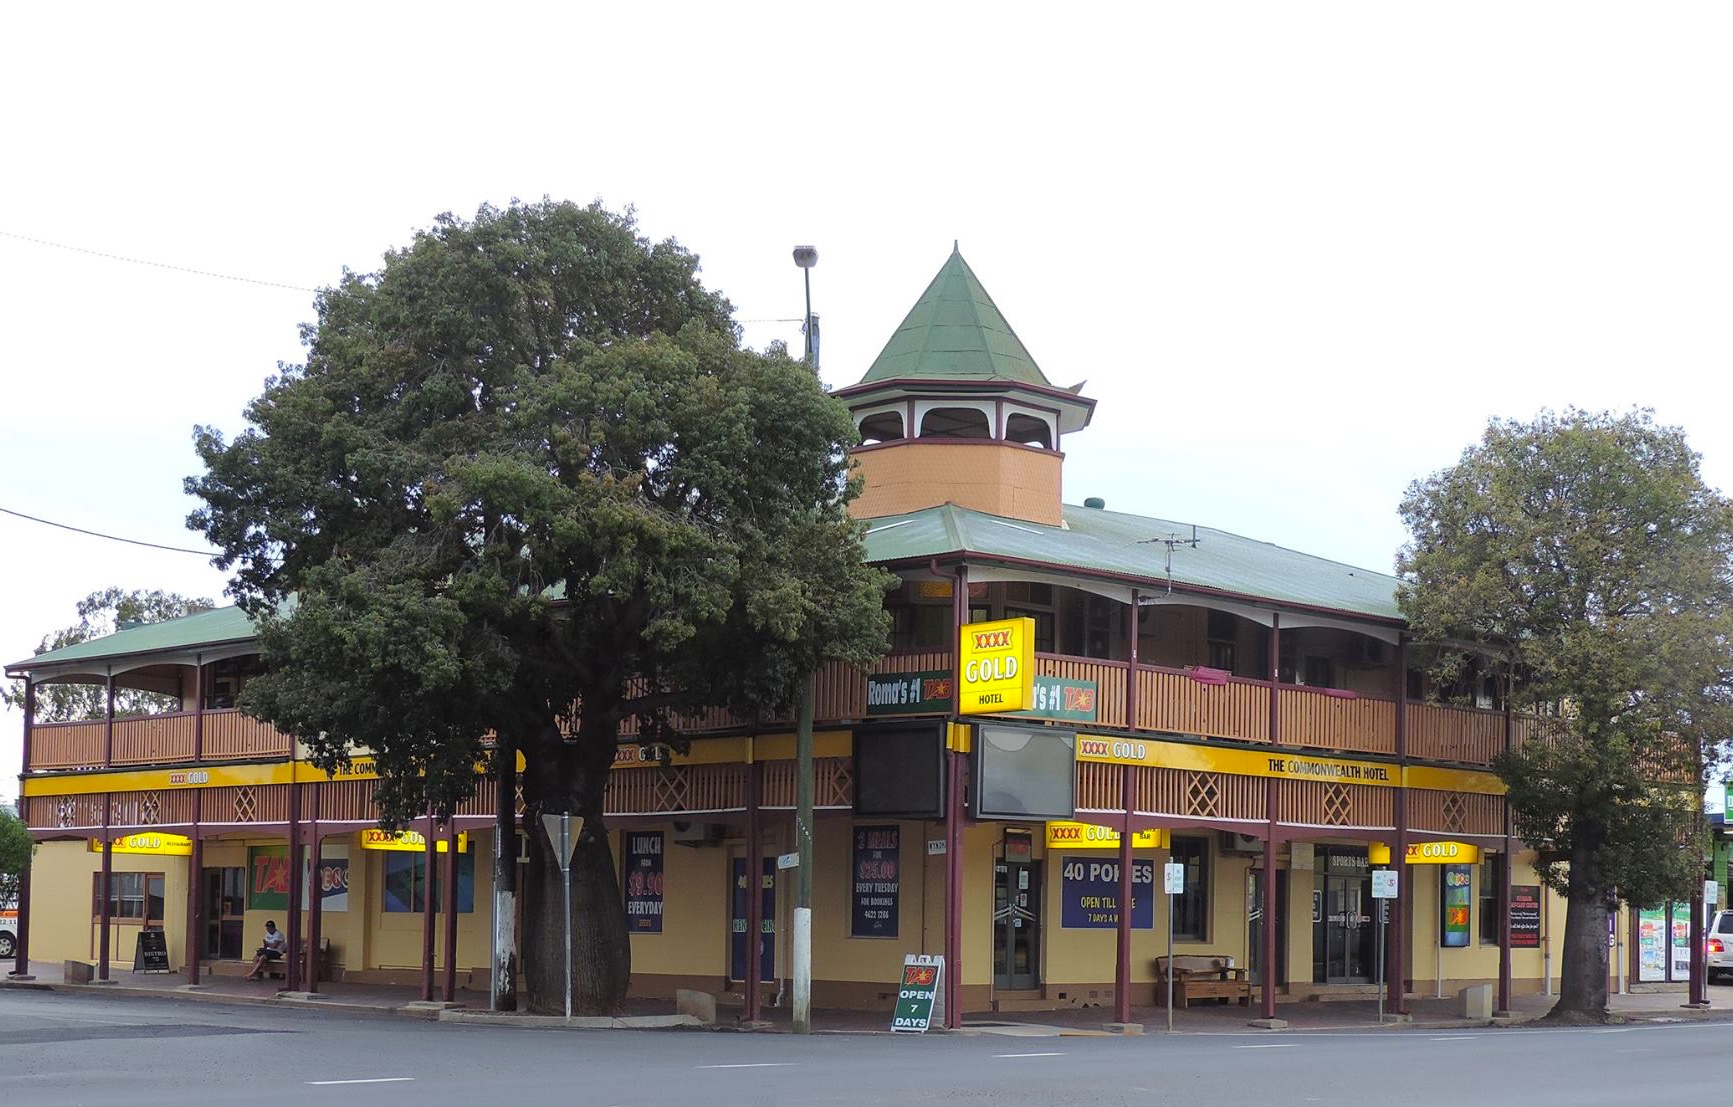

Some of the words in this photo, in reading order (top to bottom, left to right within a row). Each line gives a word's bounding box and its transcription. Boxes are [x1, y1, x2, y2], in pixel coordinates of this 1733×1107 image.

[975, 630, 1011, 649] XXXX
[965, 656, 1018, 683] GOLD
[867, 679, 908, 705] Roma's
[909, 678, 920, 703] #1
[923, 678, 952, 701] TAB
[978, 693, 1004, 705] HOTEL
[1049, 684, 1061, 711] #1
[1064, 686, 1095, 713] TAB
[1082, 741, 1108, 755] XXXX
[1112, 742, 1146, 760] GOLD
[338, 762, 353, 775] THE
[1268, 758, 1285, 772] THE
[1288, 760, 1361, 779] COMMONWEALTH
[1363, 767, 1389, 780] HOTEL
[188, 771, 208, 784] GOLD
[1053, 828, 1081, 839] XXXX
[129, 836, 161, 848] GOLD
[632, 837, 661, 854] LUNCH
[1423, 844, 1458, 857] GOLD
[1332, 855, 1356, 867] SPORTS
[1357, 857, 1369, 868] BAR
[1063, 863, 1085, 881] 40
[856, 882, 873, 893] EVERY
[874, 882, 899, 893] TUESDAY
[628, 901, 663, 915] EVERYDAY
[1081, 897, 1100, 909] OPEN
[1102, 897, 1117, 909] TILL
[1092, 914, 1108, 923] DAYS
[905, 967, 936, 986] TAB
[900, 990, 934, 1000] OPEN
[910, 1004, 919, 1013] 7
[894, 1017, 927, 1027] DAYS
